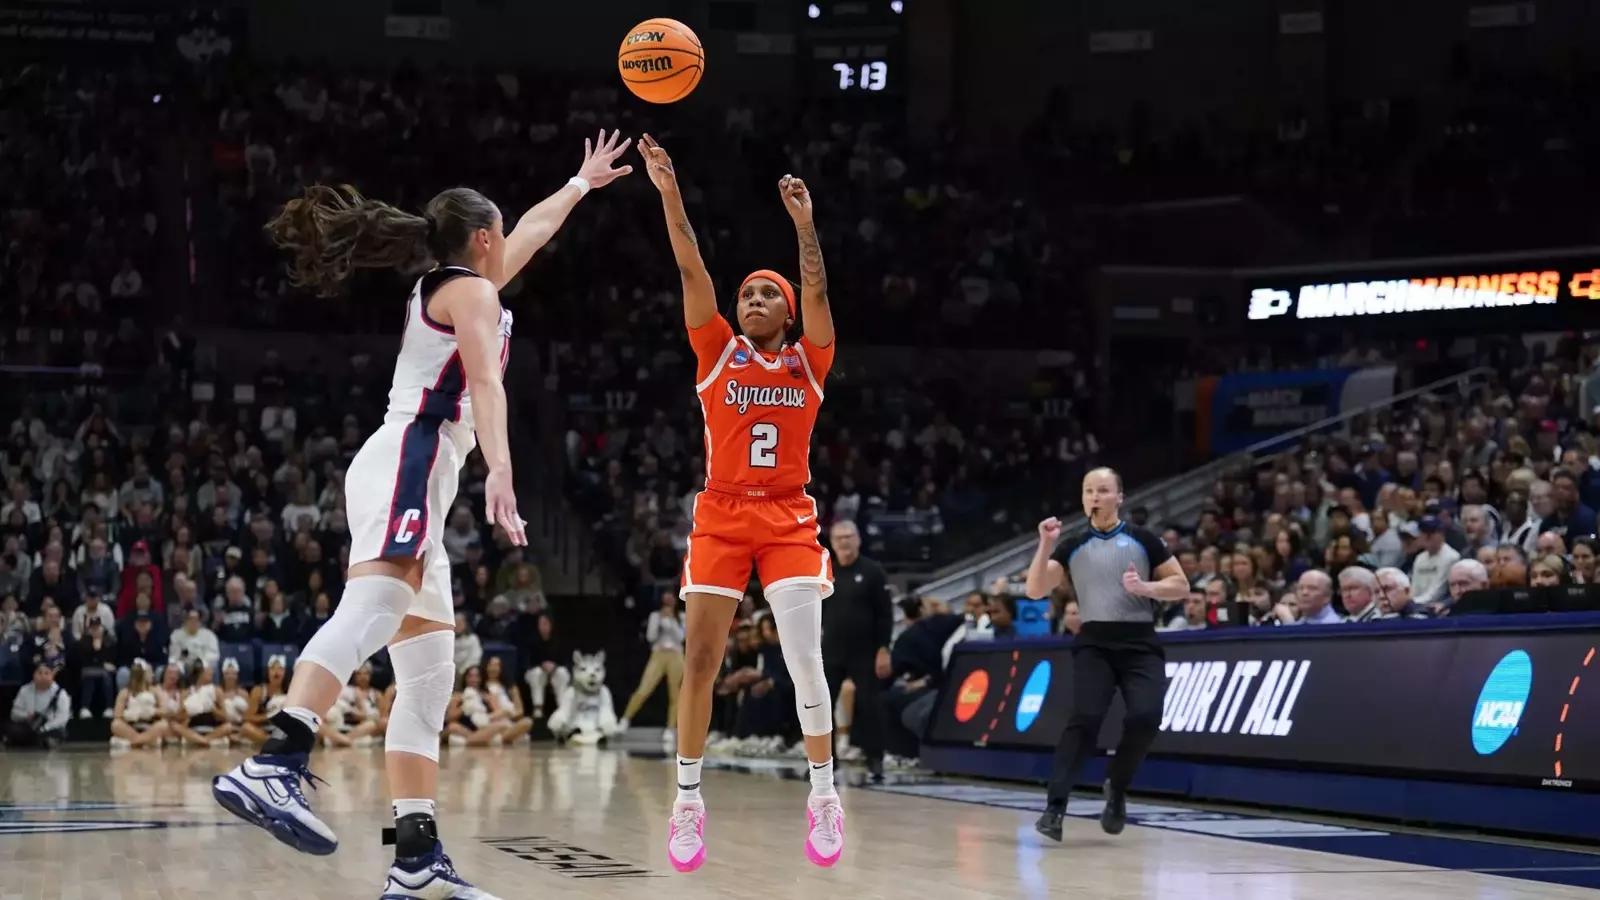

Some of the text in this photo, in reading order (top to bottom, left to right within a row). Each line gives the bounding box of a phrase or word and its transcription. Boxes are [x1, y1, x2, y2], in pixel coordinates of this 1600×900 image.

[627, 31, 665, 46] NCAA
[622, 55, 673, 74] Wilson
[833, 61, 888, 91] 7:13
[725, 380, 806, 415] Syracuse
[750, 422, 778, 468] 2
[395, 508, 420, 543] C
[1209, 660, 1262, 733] IT
[1239, 660, 1311, 736] ALL
[1475, 701, 1524, 728] NCAA
